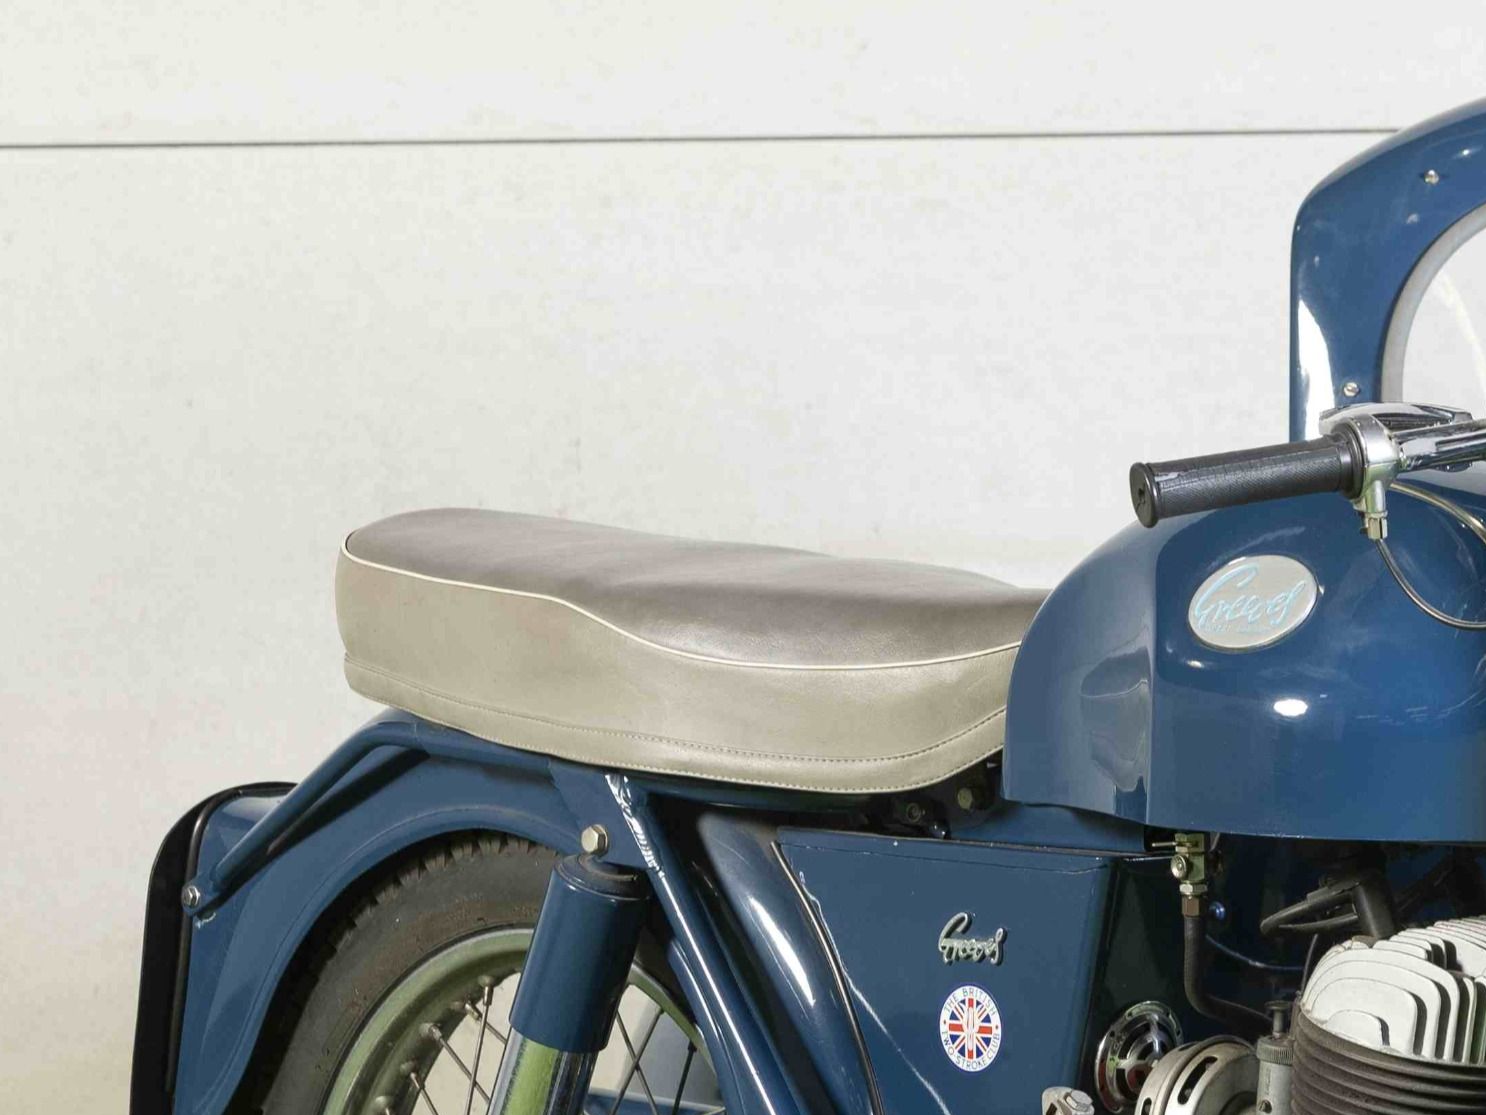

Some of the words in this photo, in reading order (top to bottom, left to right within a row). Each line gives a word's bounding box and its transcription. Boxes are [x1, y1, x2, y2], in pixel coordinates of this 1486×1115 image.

[943, 993, 958, 1013] THE
[961, 987, 997, 1016] BRITISH
[986, 1032, 1000, 1060] CLUB
